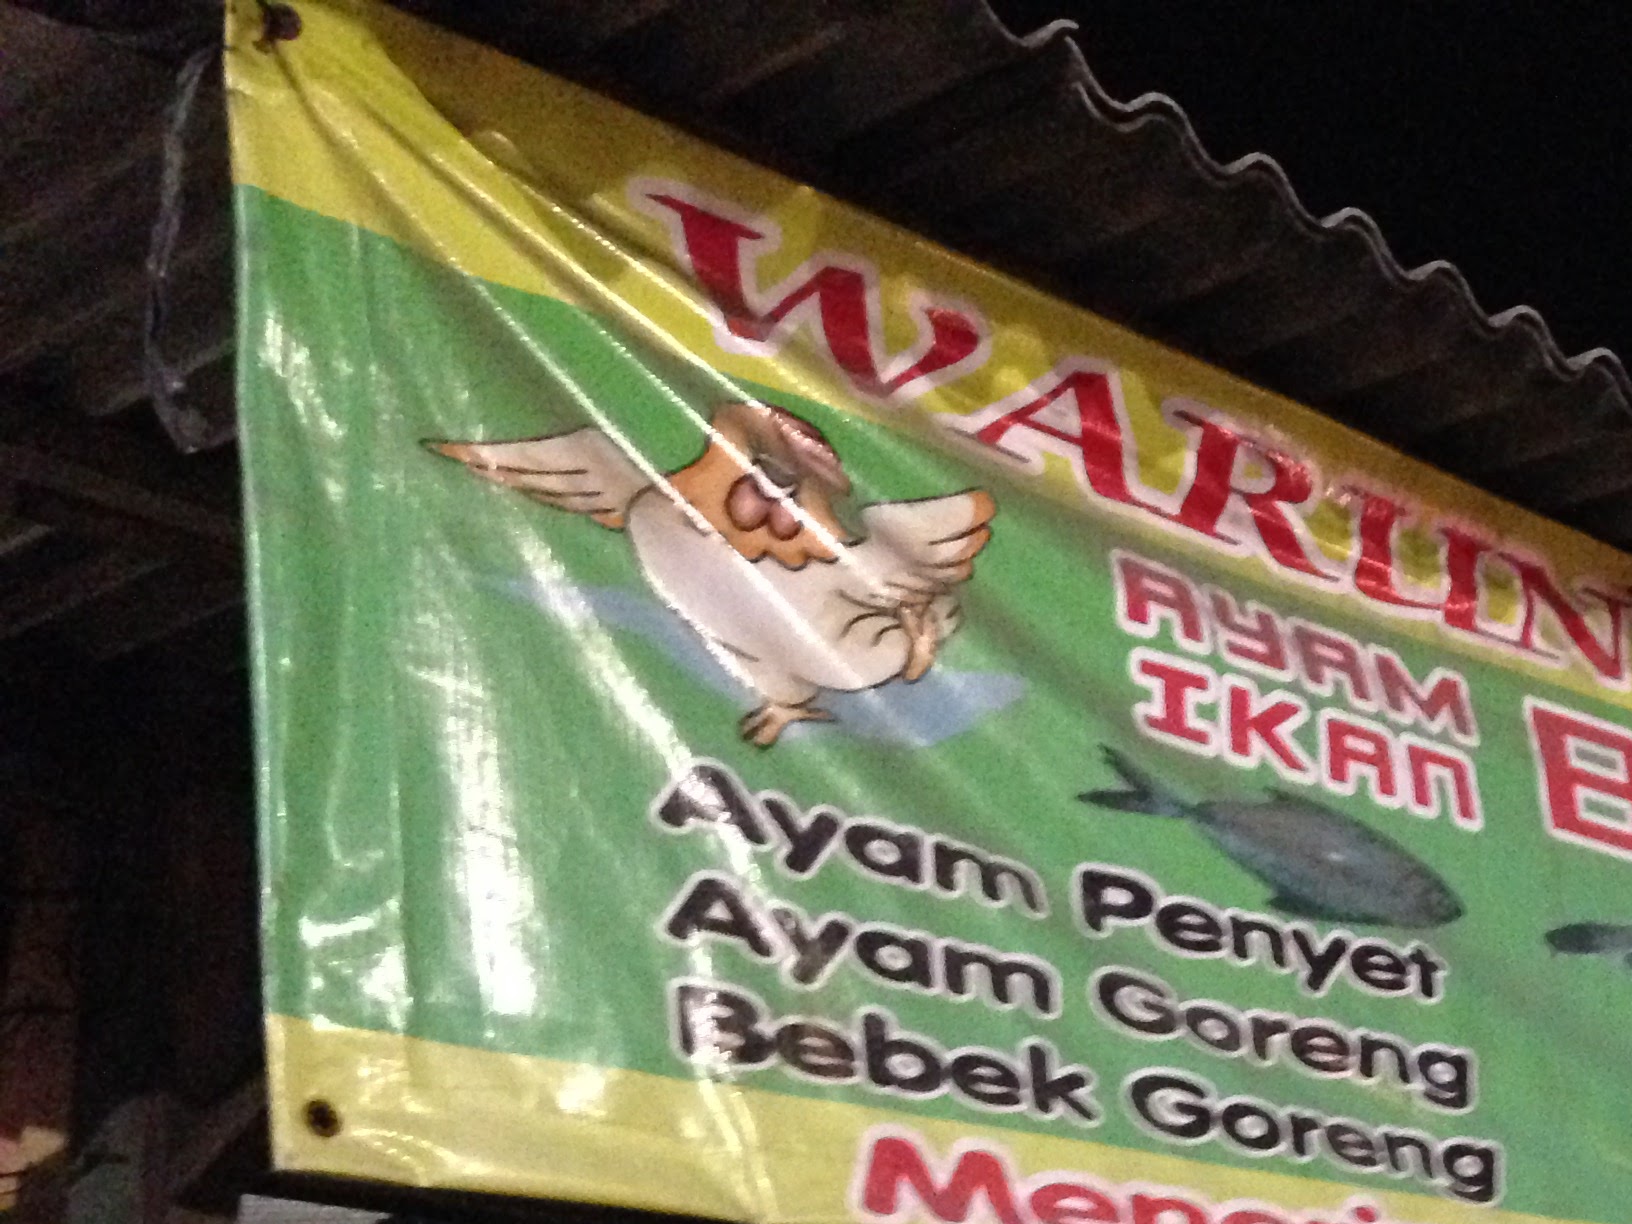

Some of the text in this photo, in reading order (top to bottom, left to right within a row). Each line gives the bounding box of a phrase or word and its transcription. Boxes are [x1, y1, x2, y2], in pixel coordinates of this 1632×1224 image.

[1119, 560, 1472, 736] AYAM
[1138, 660, 1476, 824] IKAN
[657, 762, 1446, 997] Ayam Penyet
[666, 877, 1470, 1110] Ayam Goreng
[677, 986, 1498, 1202] Bebek Goreng
